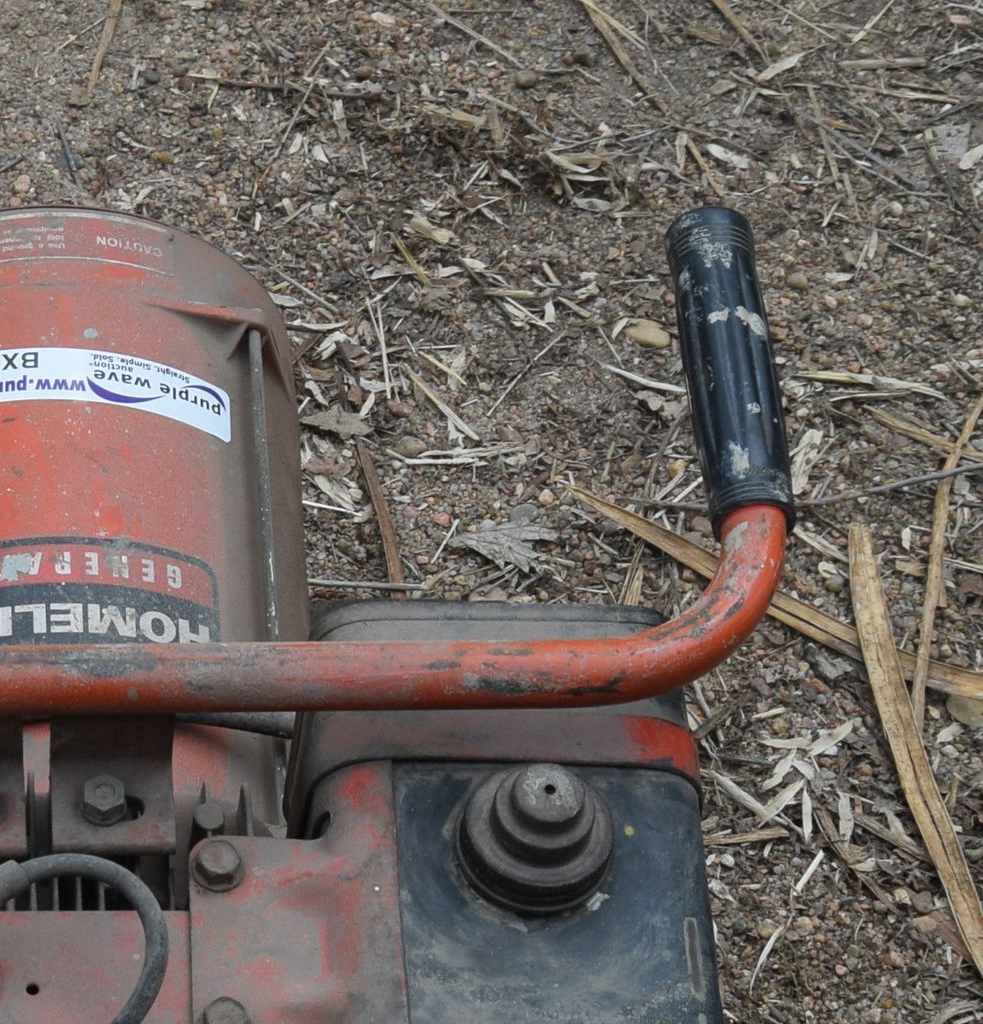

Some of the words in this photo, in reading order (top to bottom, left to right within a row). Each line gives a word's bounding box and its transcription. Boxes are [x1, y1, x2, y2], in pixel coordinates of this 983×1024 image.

[96, 235, 163, 258] CAUTION
[1, 351, 40, 372] BX
[89, 352, 115, 364] Sold.
[118, 356, 153, 372] Simple.
[93, 369, 152, 393] wave
[151, 364, 191, 384] Straight.
[159, 383, 222, 417] purple
